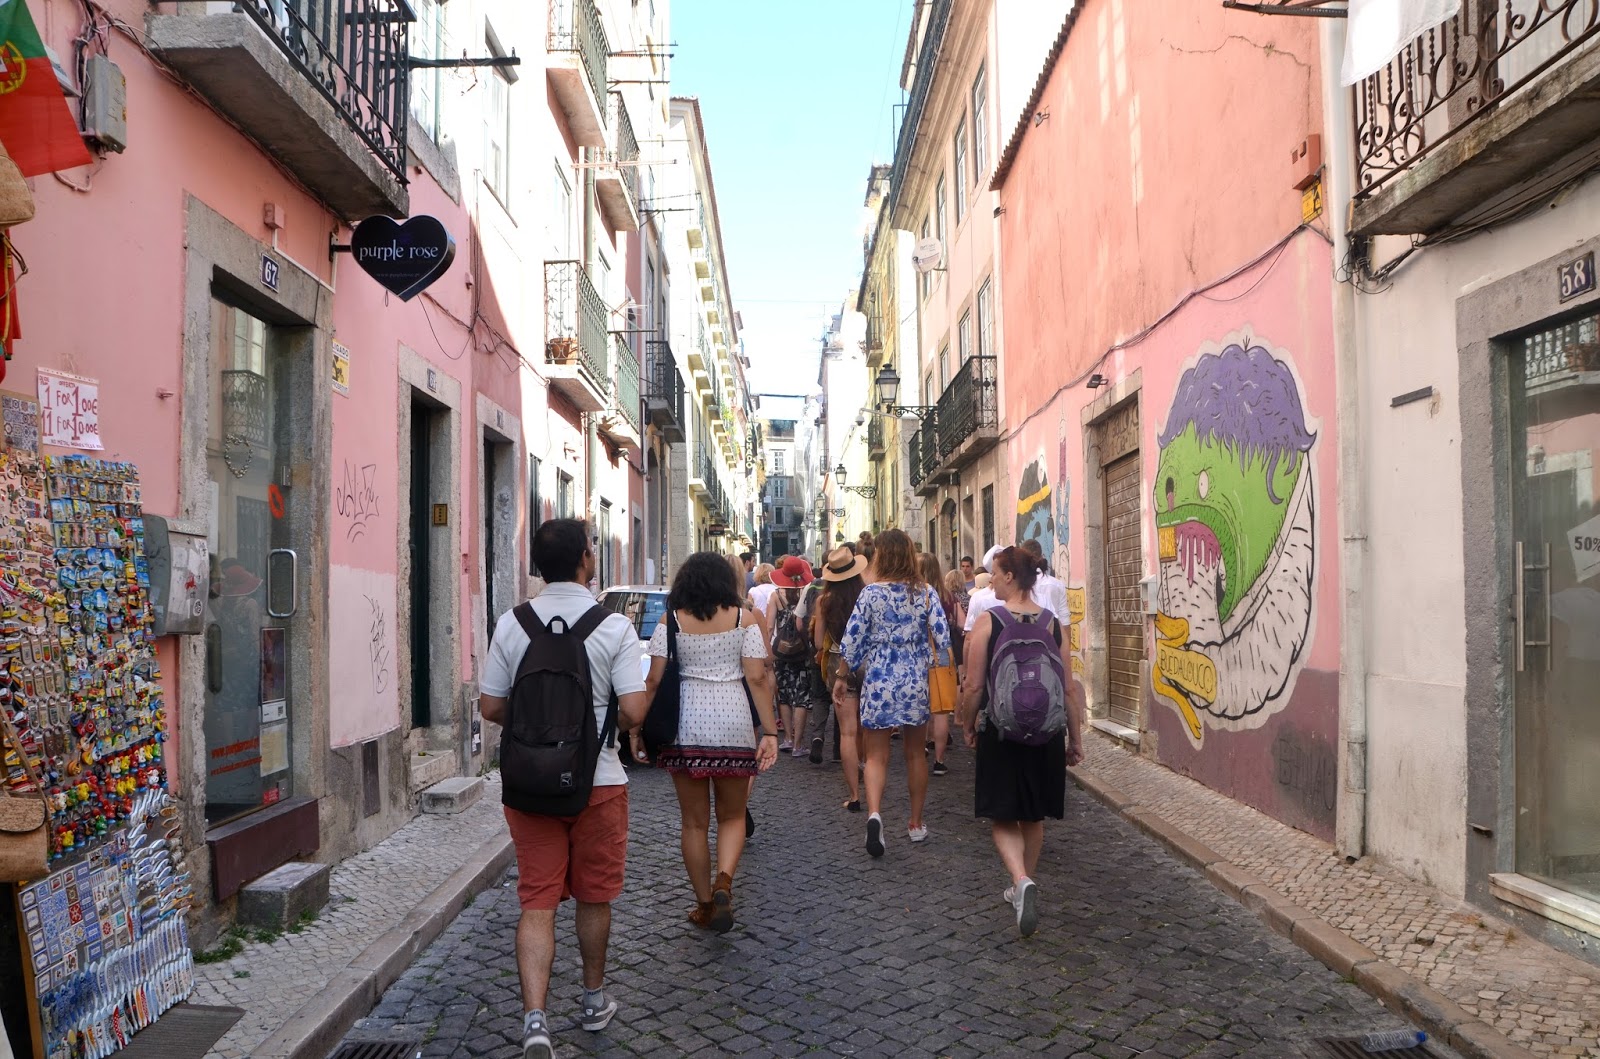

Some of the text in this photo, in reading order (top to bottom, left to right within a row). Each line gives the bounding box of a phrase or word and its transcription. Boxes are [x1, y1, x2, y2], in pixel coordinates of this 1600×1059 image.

[360, 239, 439, 261] purple rose
[265, 261, 278, 286] 67
[1561, 259, 1586, 296] 58
[56, 390, 73, 407] FOR
[57, 415, 75, 434] FOR
